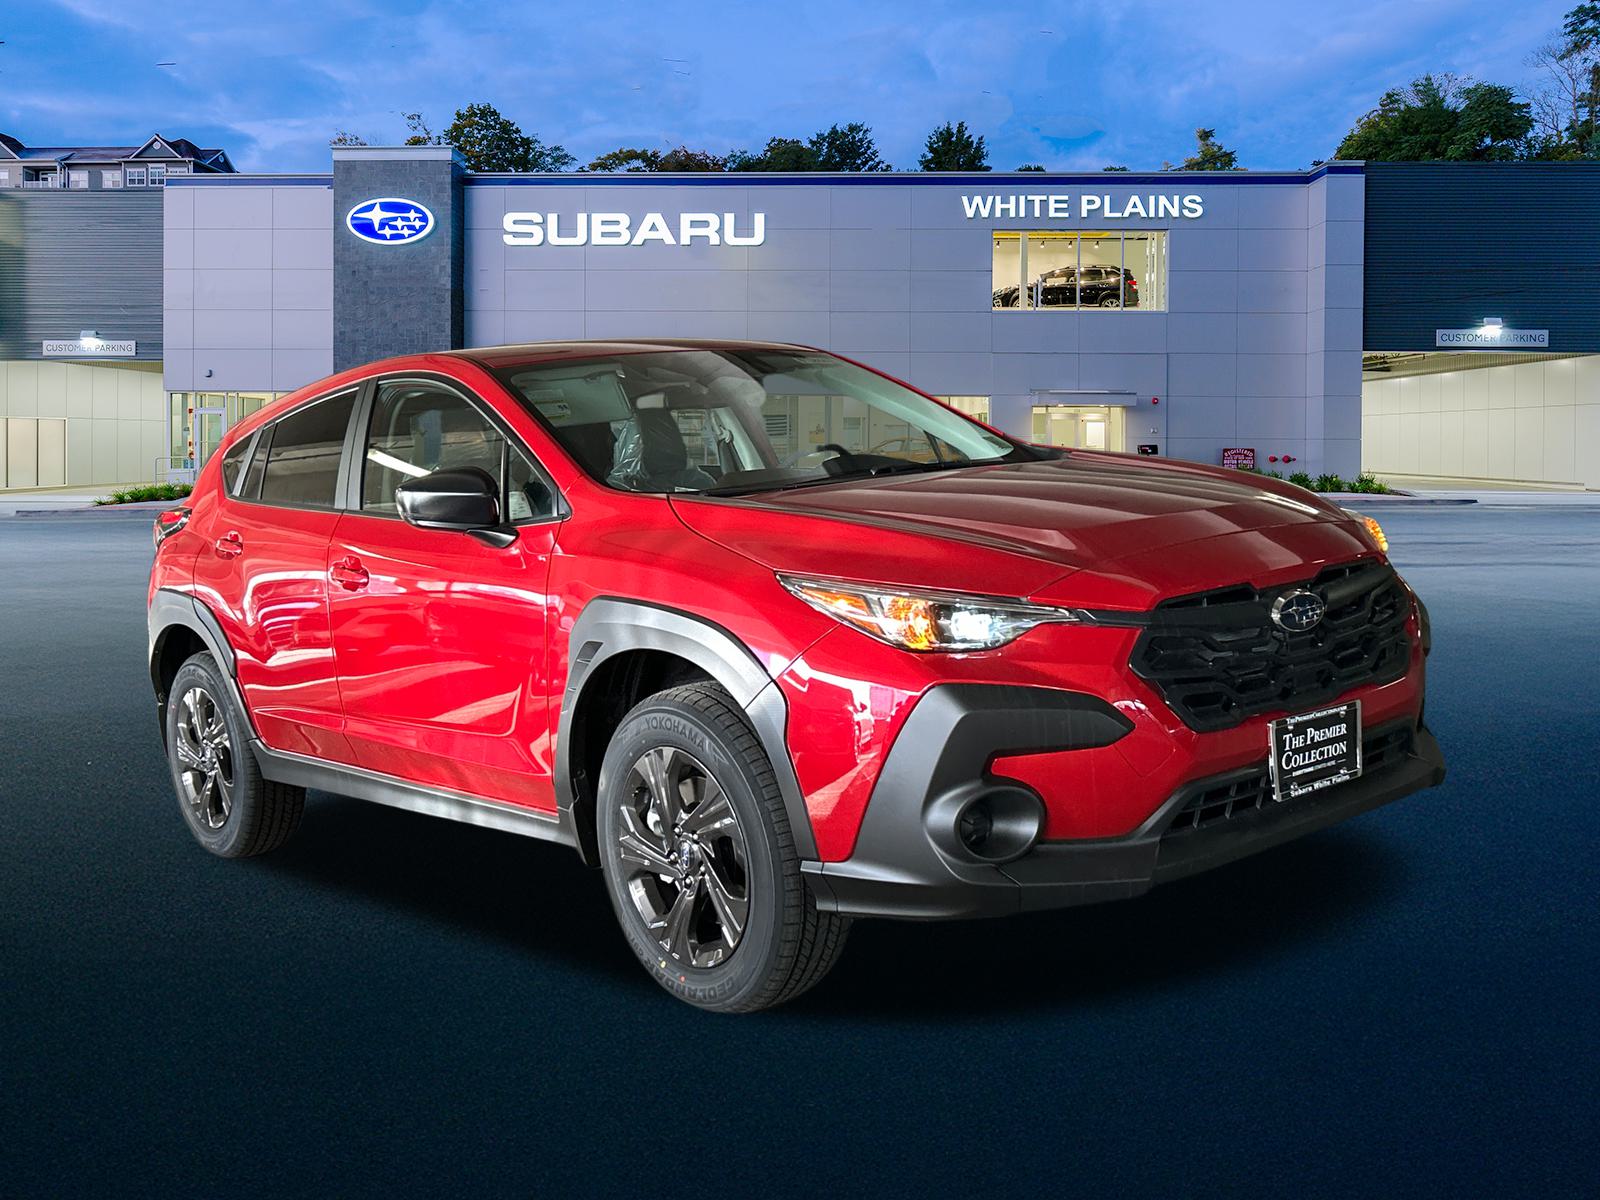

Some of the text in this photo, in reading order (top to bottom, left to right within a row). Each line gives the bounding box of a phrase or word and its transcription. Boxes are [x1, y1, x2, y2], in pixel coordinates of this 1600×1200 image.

[961, 195, 1204, 218] WHITE PLAINS
[502, 212, 765, 246] SUBARU
[45, 343, 133, 352] CUSTOMER PARKING
[1440, 333, 1545, 343] CUSTOMER PARKING
[645, 716, 705, 752] YOKOHAMA
[1283, 723, 1347, 751] THE PREMIER
[1281, 741, 1347, 770] COLLECTION
